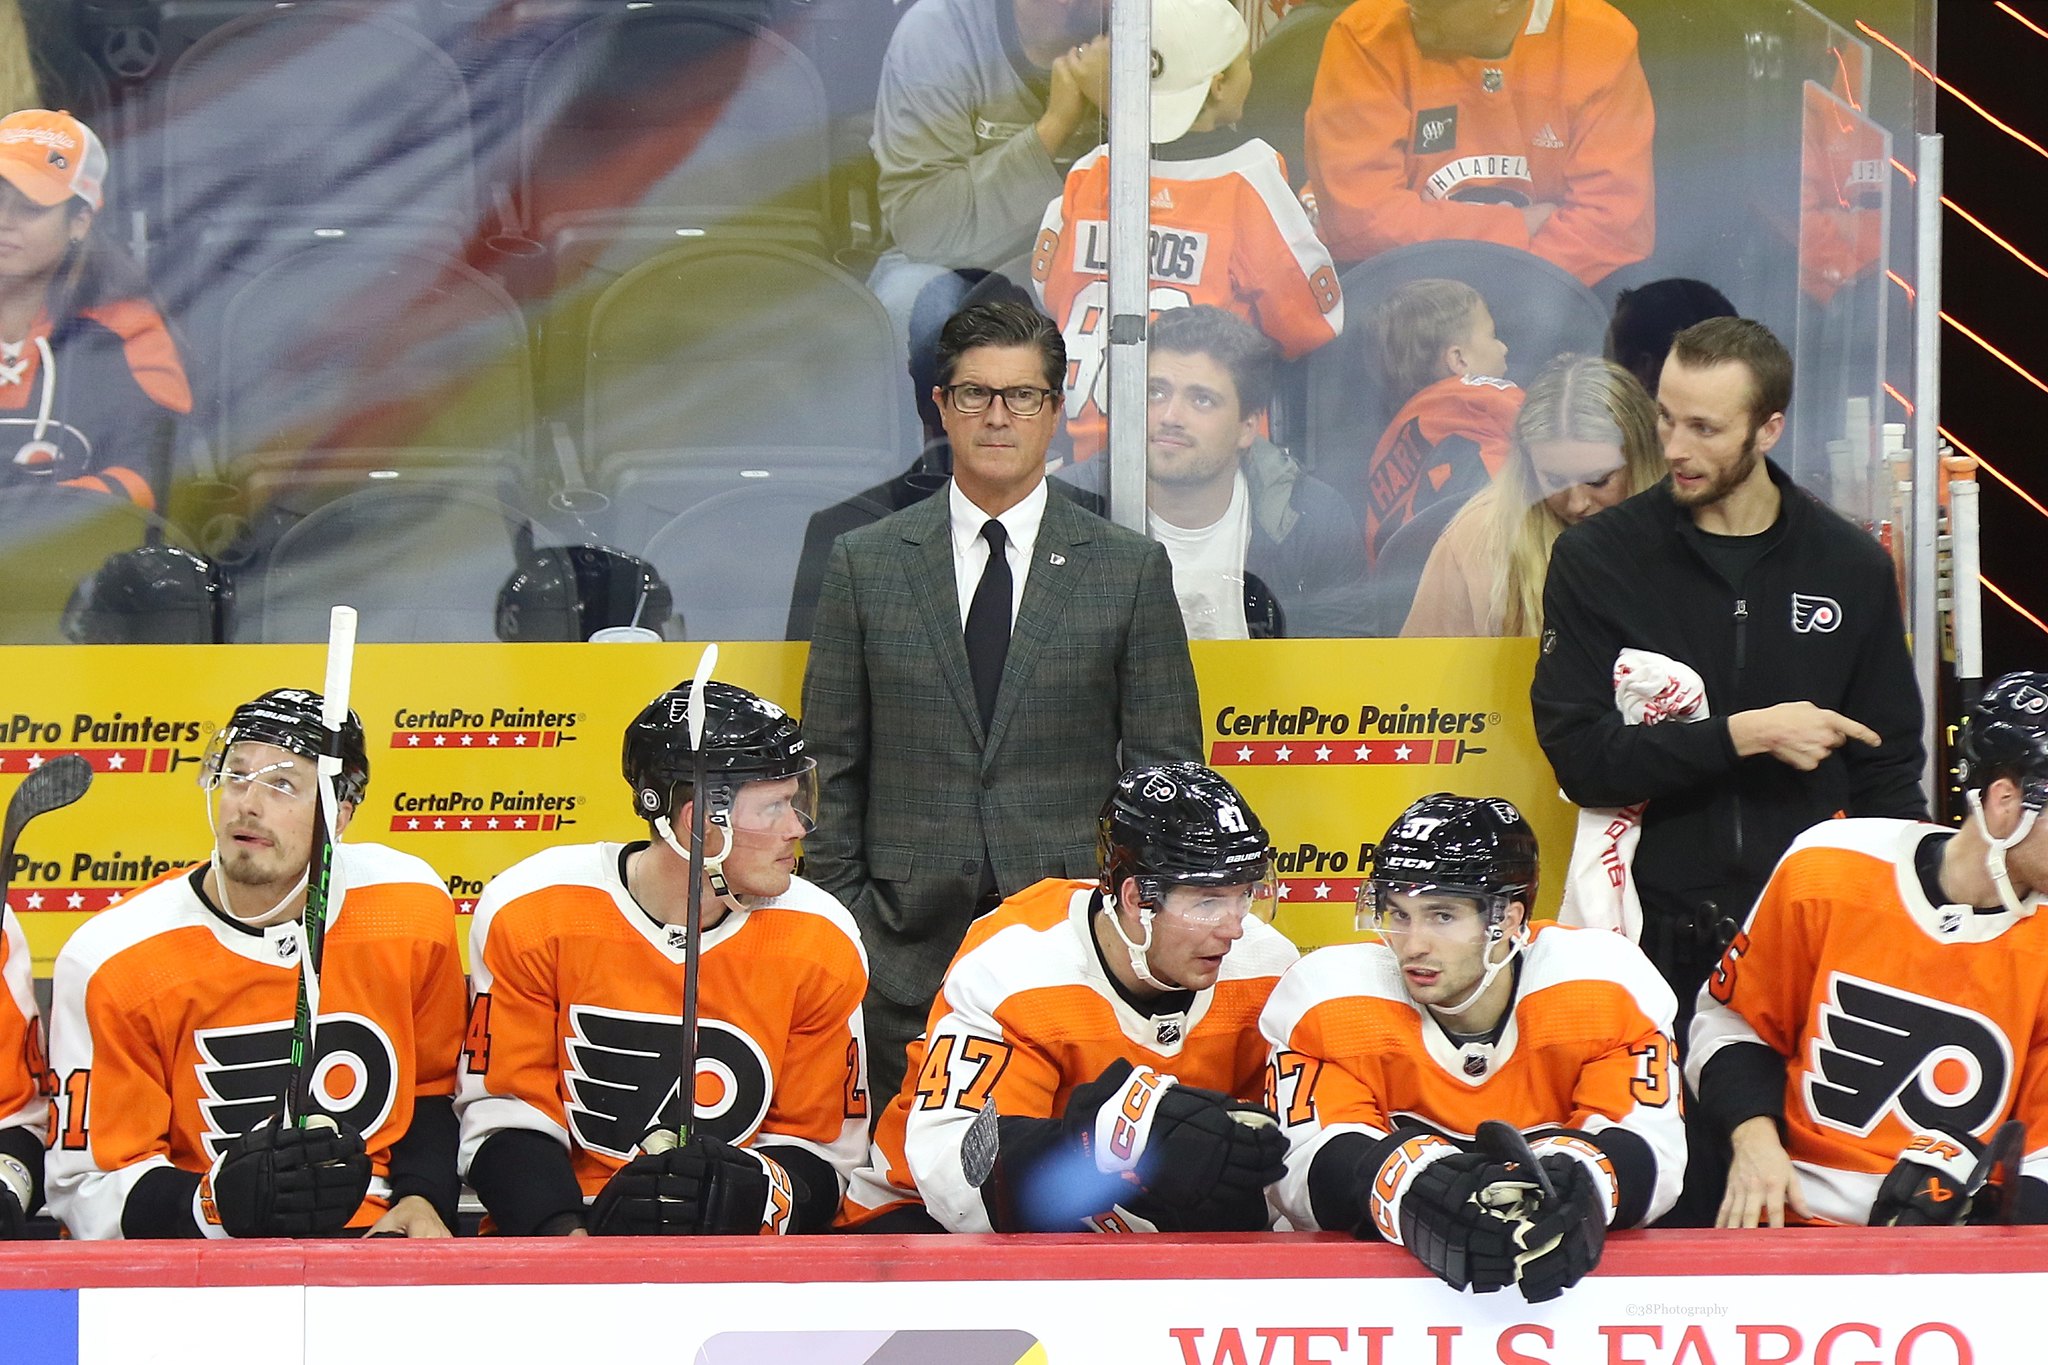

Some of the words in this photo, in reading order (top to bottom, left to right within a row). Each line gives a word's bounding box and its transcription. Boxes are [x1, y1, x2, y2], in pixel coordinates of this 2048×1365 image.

[1425, 156, 1530, 200] PHILADEL
[254, 709, 301, 725] BAUER
[395, 709, 484, 728] CertaPro
[491, 707, 576, 727] Painters
[1216, 707, 1349, 735] CertaPro
[394, 792, 483, 811] CertaPro
[491, 791, 575, 810] Painters
[1225, 851, 1261, 864] BAUER
[1388, 857, 1435, 870] CCM
[463, 992, 492, 1075] 4
[843, 1037, 867, 1118] 2
[914, 1034, 1013, 1113] 47
[1370, 1135, 1451, 1239] CCM
